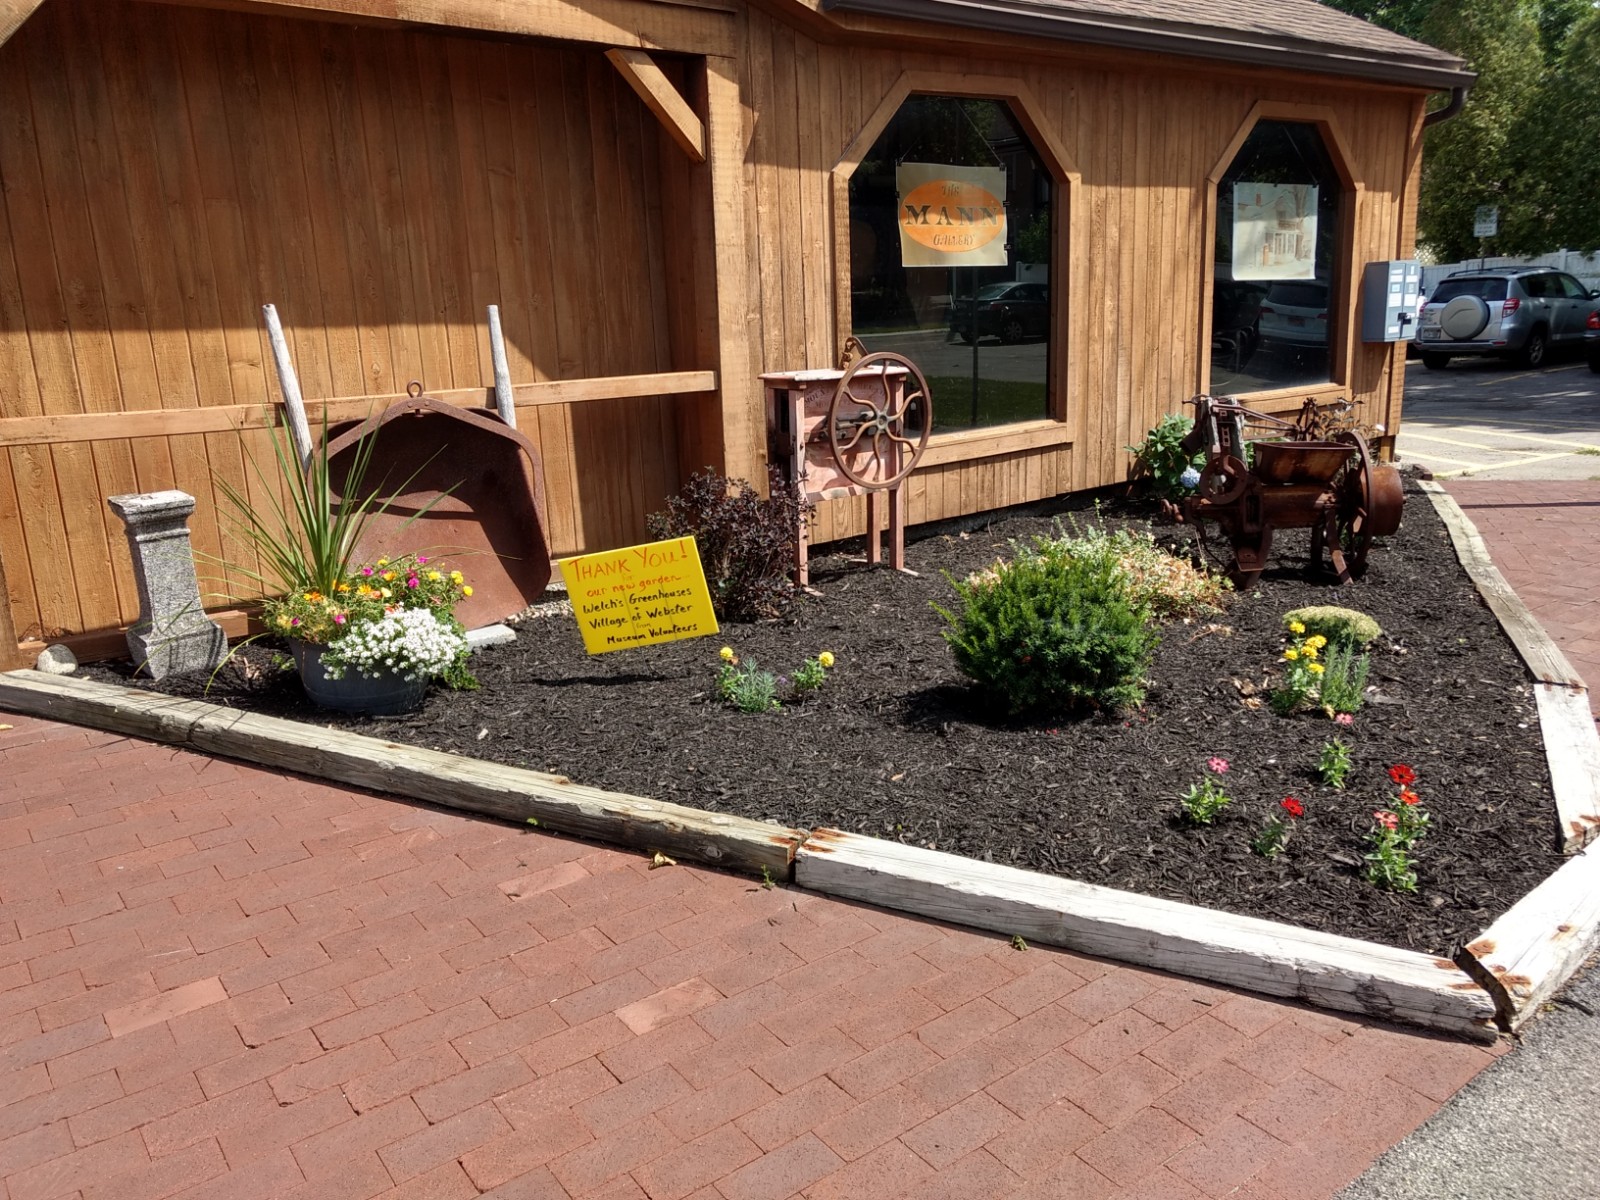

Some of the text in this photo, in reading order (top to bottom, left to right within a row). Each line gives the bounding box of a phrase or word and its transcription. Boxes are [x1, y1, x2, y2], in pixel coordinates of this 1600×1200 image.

[905, 205, 997, 226] MANN
[933, 233, 975, 246] GALLERY
[568, 540, 688, 582] THANK YOU!
[587, 575, 682, 597] our new garden
[583, 588, 692, 615] Welch's Greenhouses
[589, 604, 693, 630] Village of Webster
[607, 623, 698, 644] Museum Volunteers
